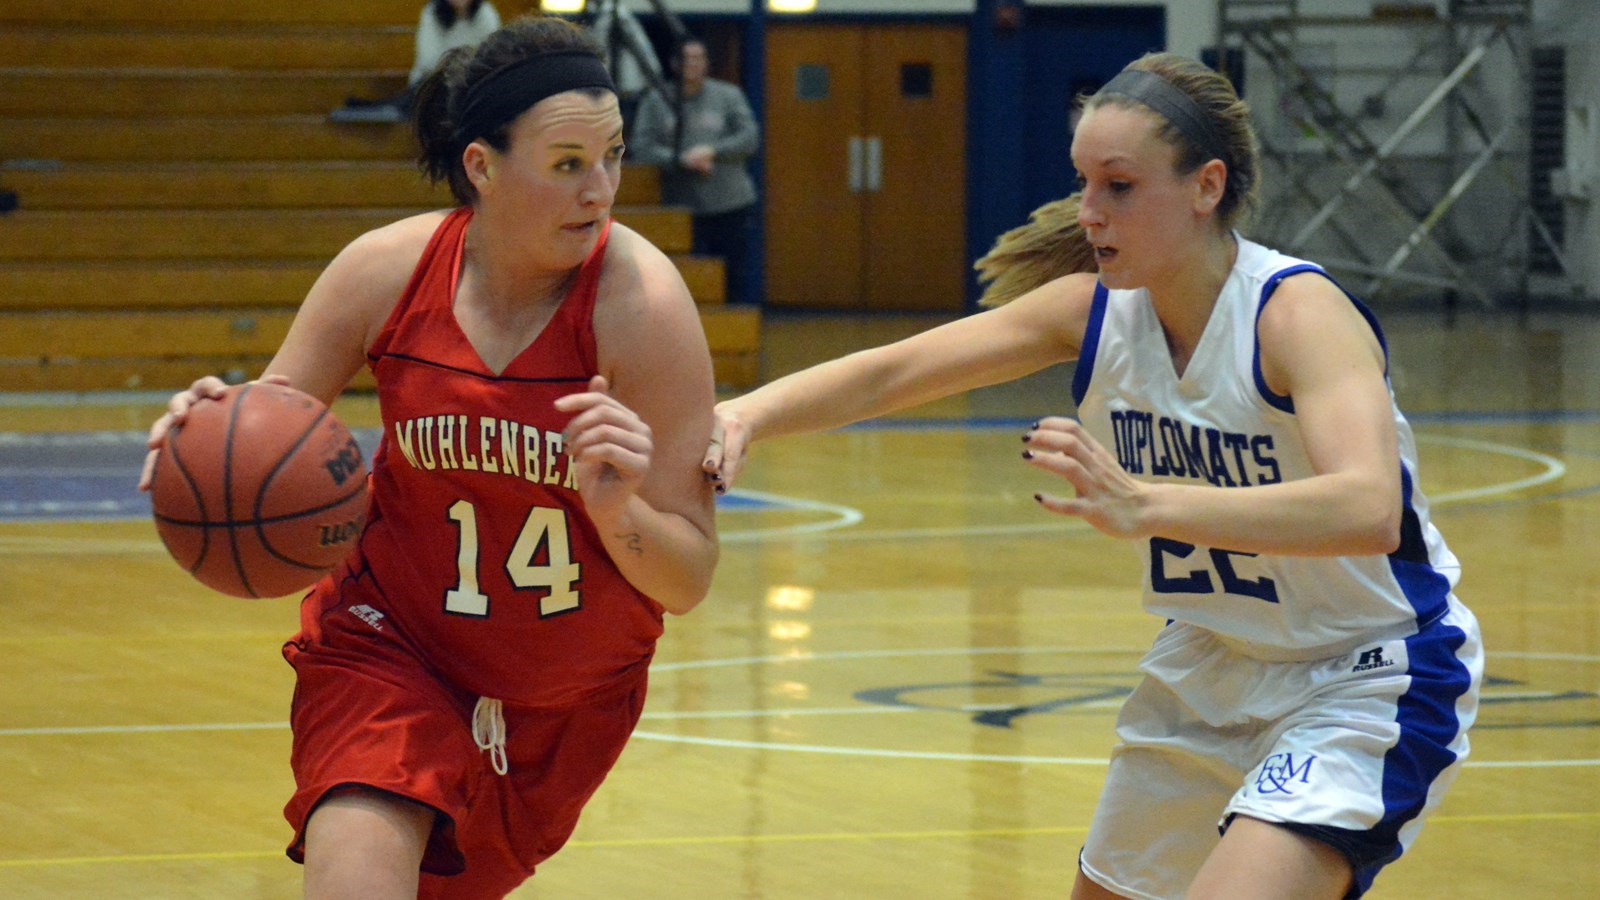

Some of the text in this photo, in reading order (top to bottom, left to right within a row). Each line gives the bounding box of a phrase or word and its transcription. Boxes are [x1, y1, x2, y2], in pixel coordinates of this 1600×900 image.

[1111, 410, 1282, 488] DIPLOMATS
[443, 499, 582, 619] 14
[1352, 659, 1395, 672] RUSSELL
